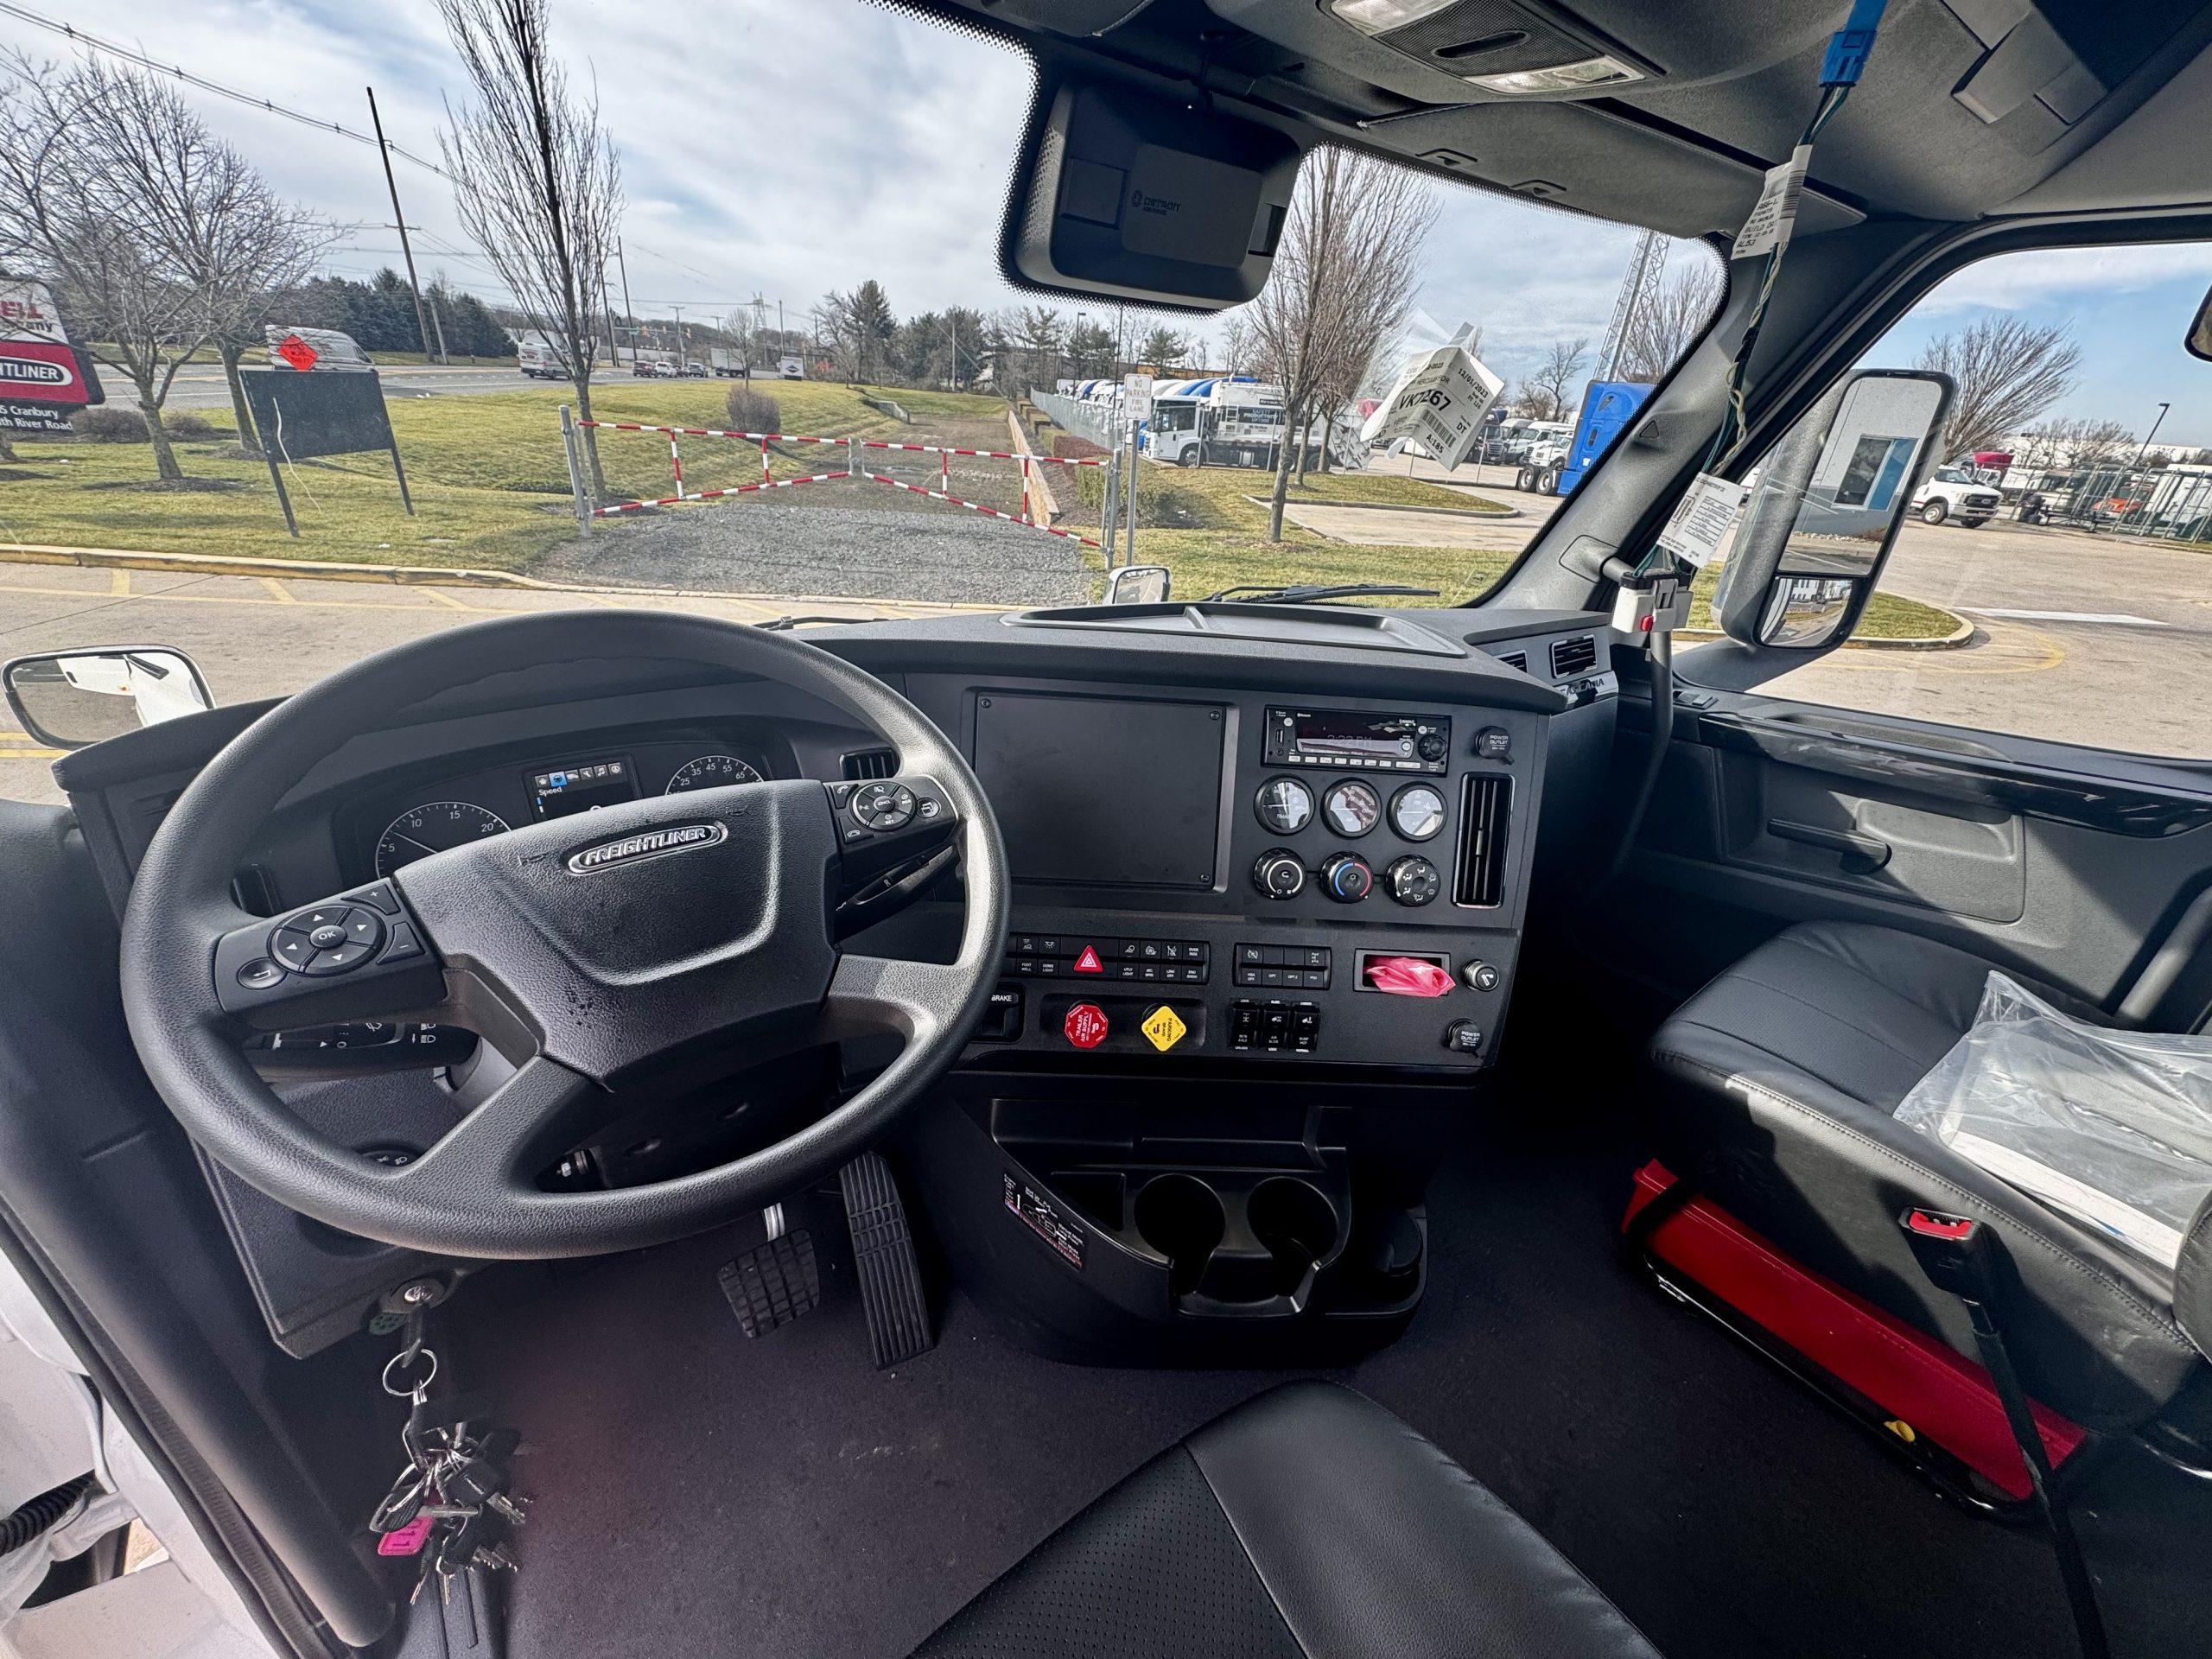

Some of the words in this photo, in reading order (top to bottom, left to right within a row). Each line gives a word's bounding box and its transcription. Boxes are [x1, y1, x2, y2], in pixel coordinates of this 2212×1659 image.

[1134, 379, 1143, 388] NO
[1458, 368, 1489, 398] 12/01/2023
[1126, 388, 1150, 398] PARKING
[10, 405, 59, 420] Cranbury
[15, 418, 42, 429] River
[45, 420, 73, 430] Road
[1456, 422, 1468, 434] DT
[691, 767, 702, 776] 35
[735, 771, 746, 779] 65
[680, 778, 690, 786] 25
[538, 785, 563, 797] Speed
[449, 810, 461, 820] 15
[410, 818, 423, 828] 10
[480, 823, 494, 832] 20
[388, 843, 396, 852] 5
[585, 827, 706, 866] FREIGHTLINER
[883, 879, 891, 887] R
[318, 930, 336, 941] OK
[1075, 1014, 1084, 1037] TRAILER
